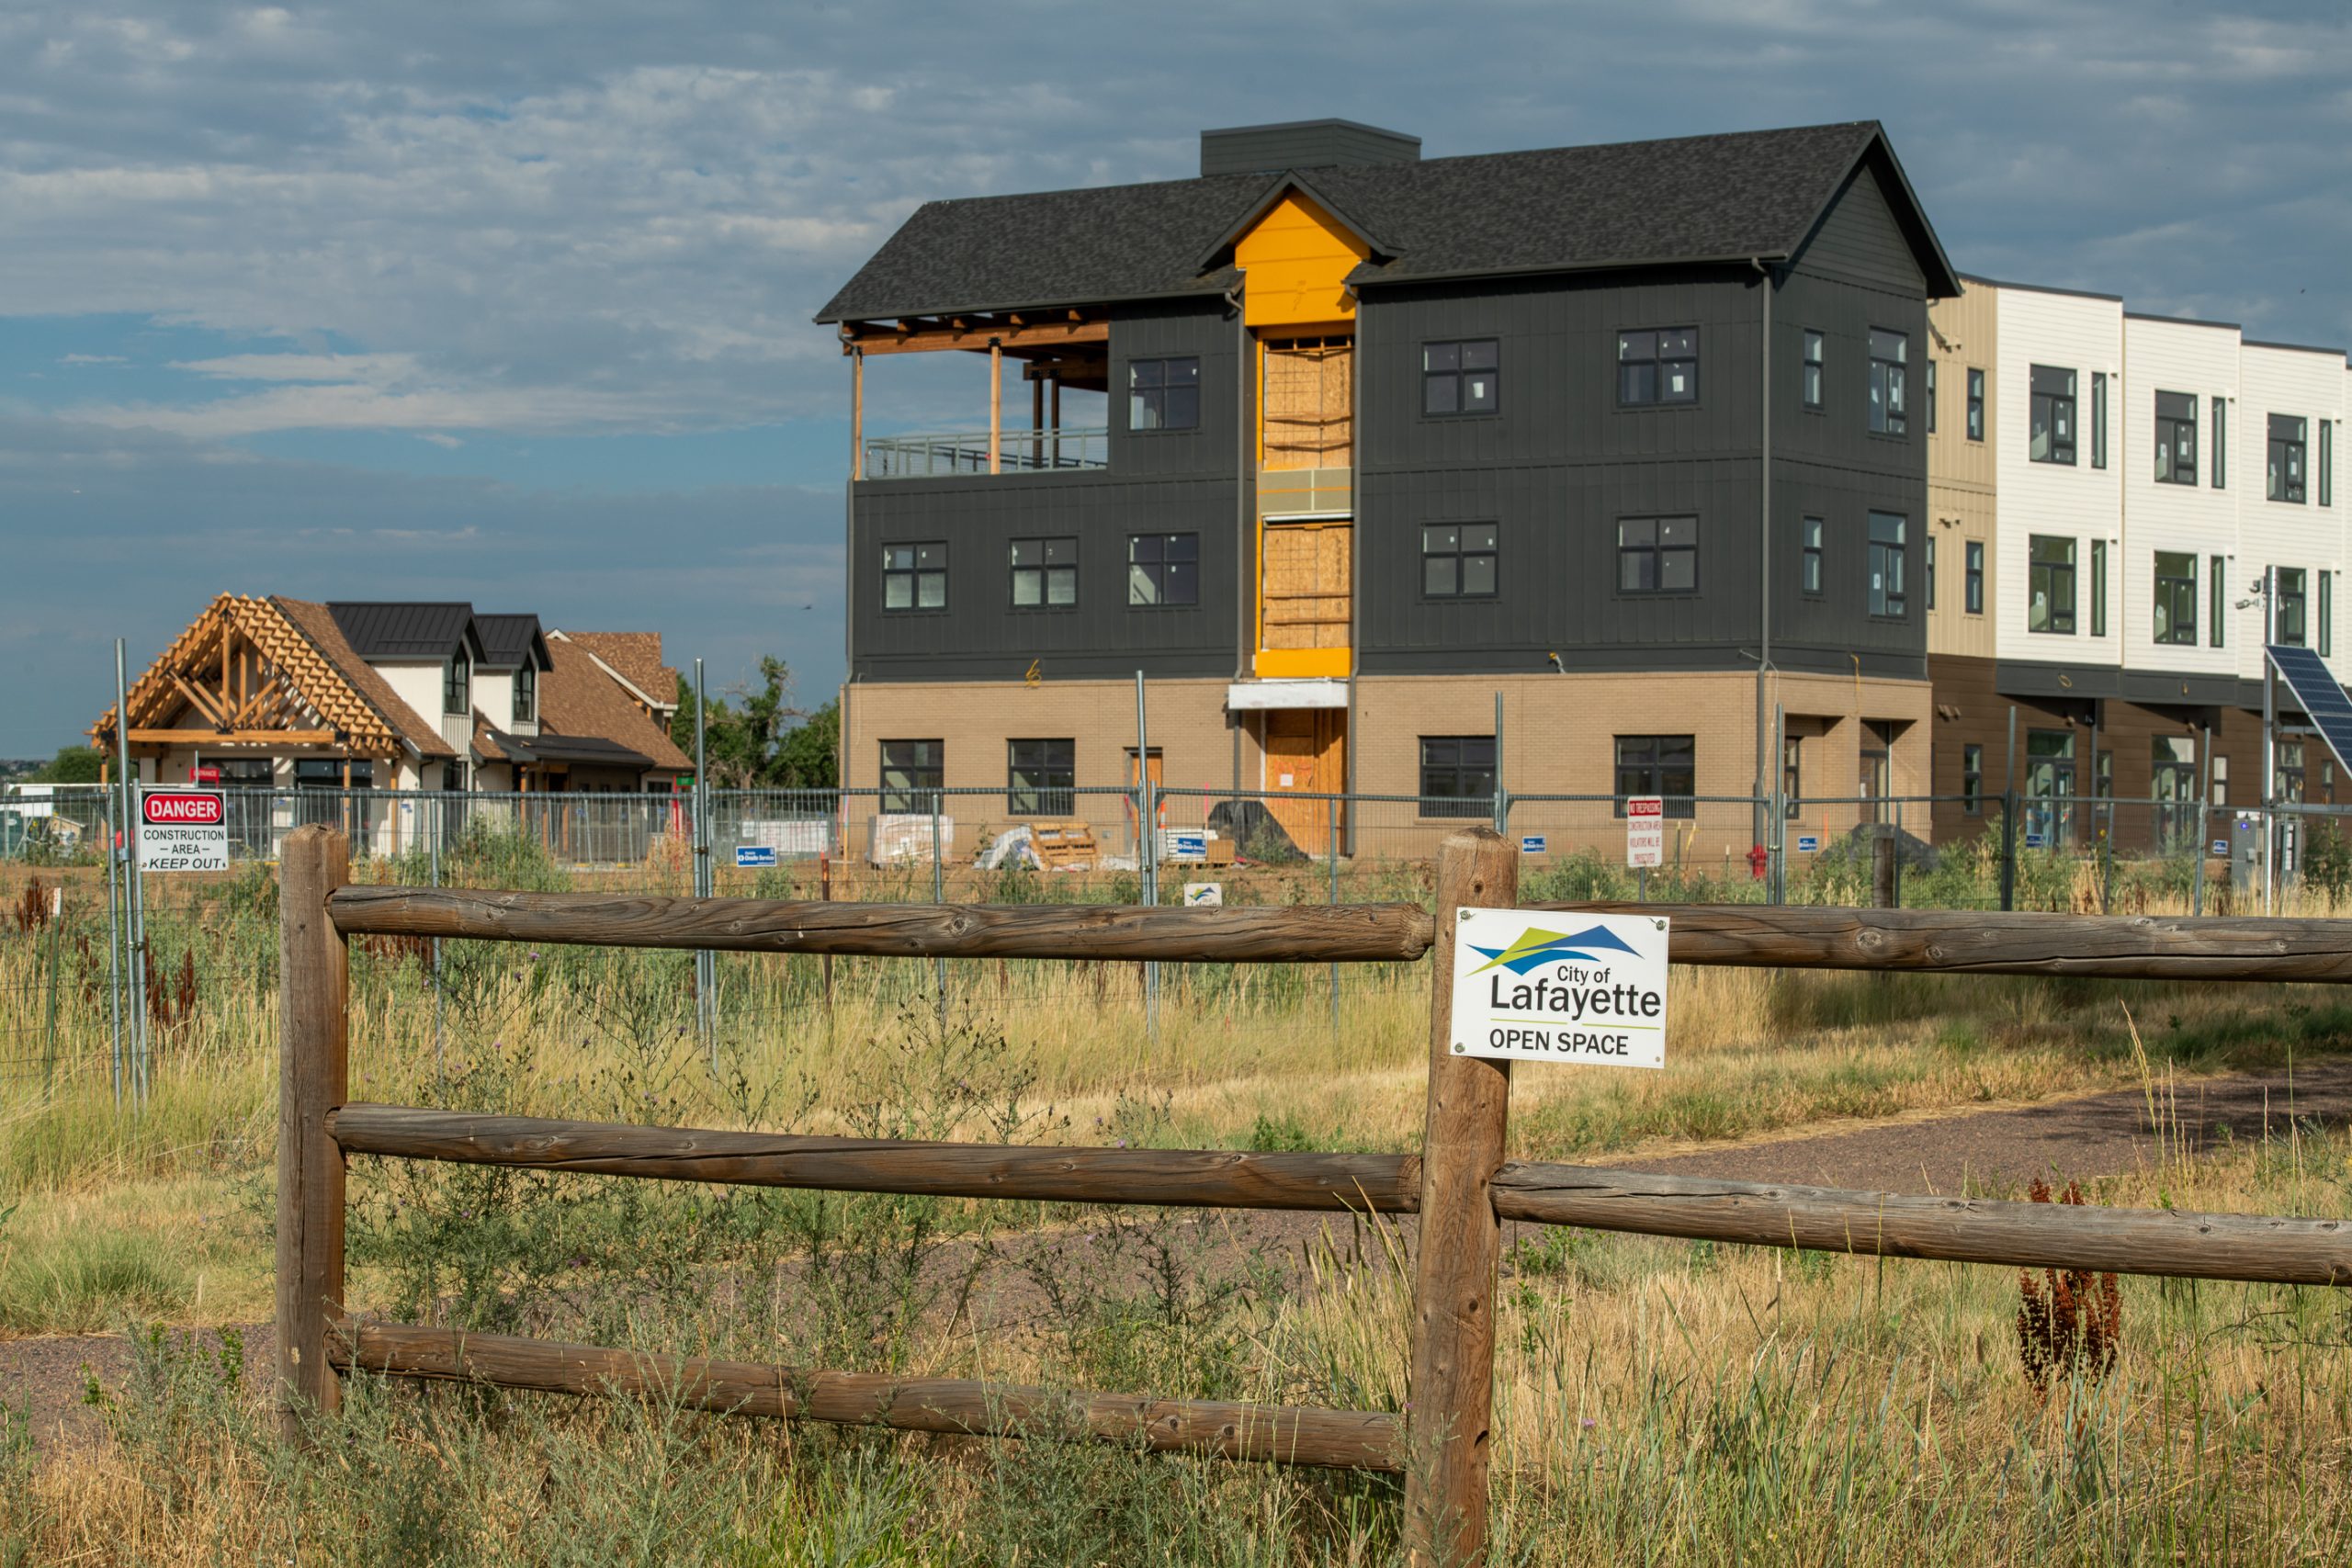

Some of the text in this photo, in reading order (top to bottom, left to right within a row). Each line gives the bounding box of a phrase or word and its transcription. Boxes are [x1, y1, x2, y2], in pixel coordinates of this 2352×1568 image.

[151, 800, 218, 818] DANGER
[1629, 802, 1661, 814] NO TRESPASSING
[144, 829, 224, 840] CONSTRUCTION
[172, 844, 200, 854] AREA
[149, 858, 221, 869] KEEP OUT
[1557, 965, 1611, 986] City of
[1490, 974, 1661, 1021] Lafayette
[1489, 1029, 1629, 1055] OPEN SPACE
